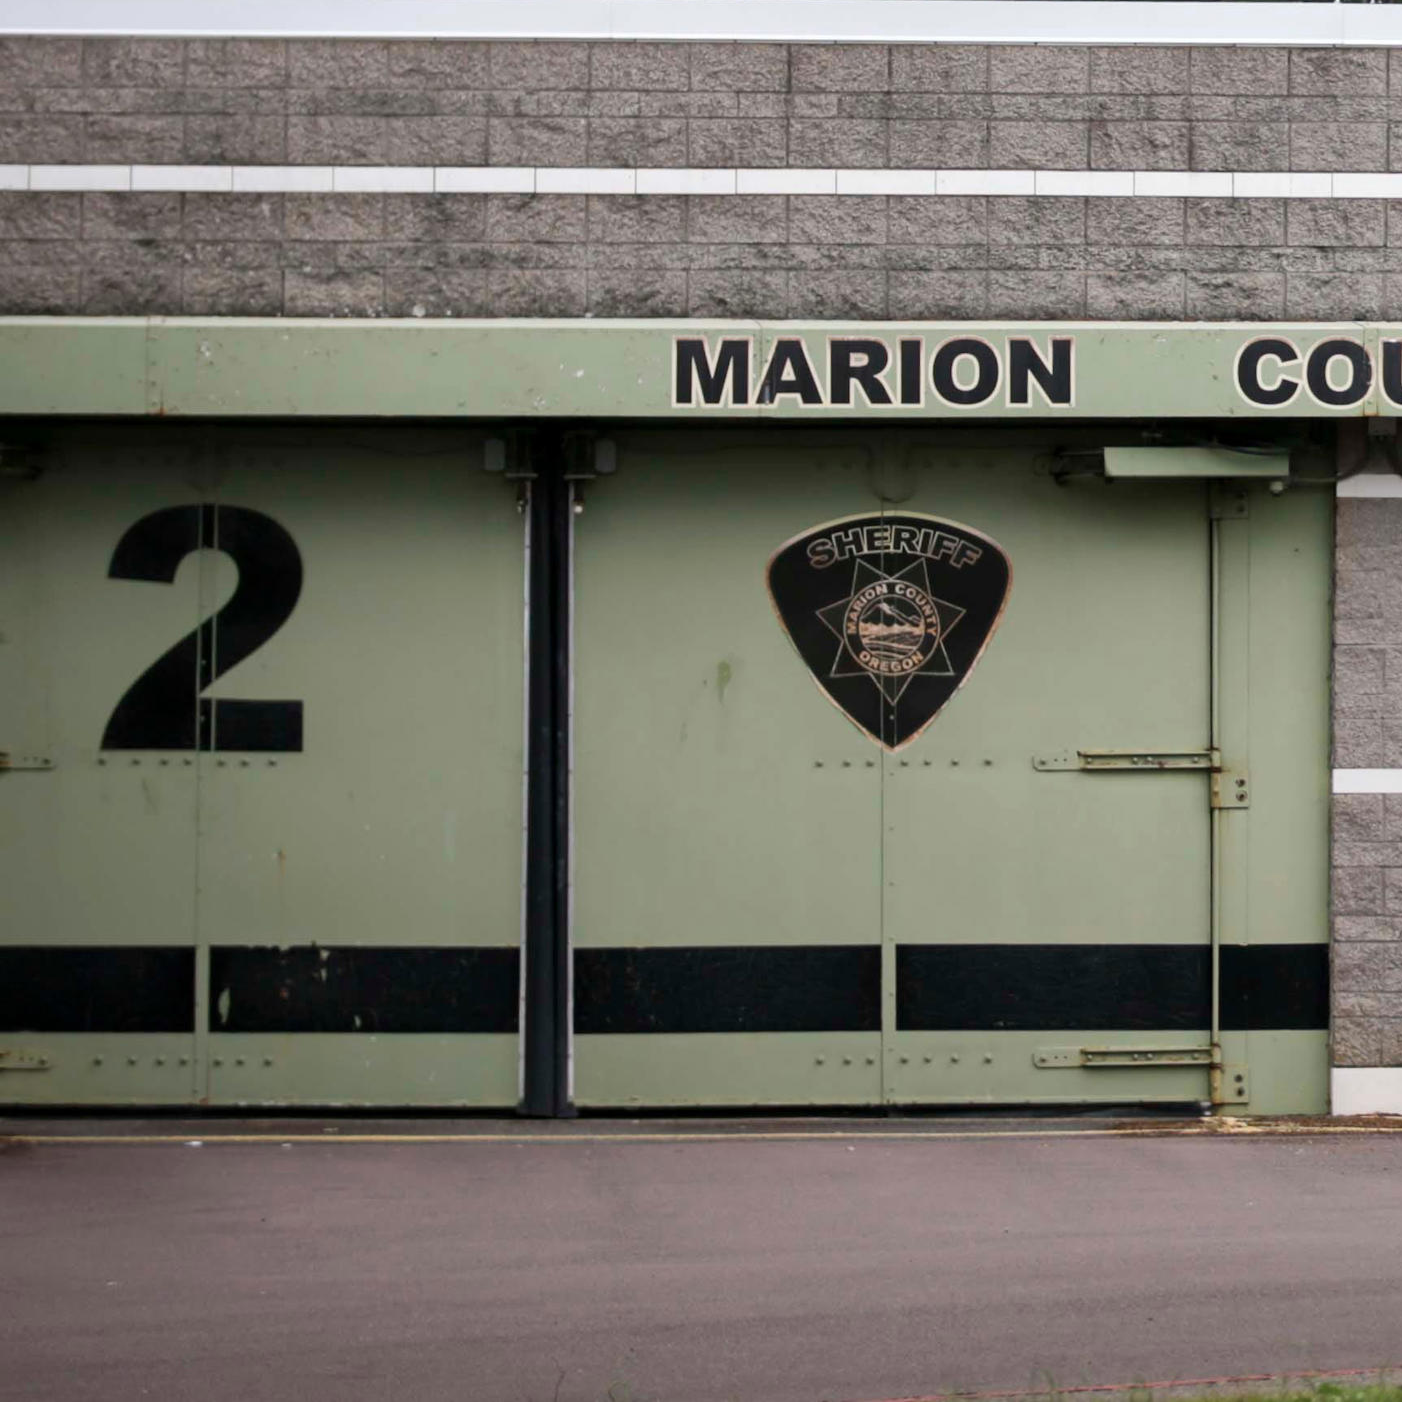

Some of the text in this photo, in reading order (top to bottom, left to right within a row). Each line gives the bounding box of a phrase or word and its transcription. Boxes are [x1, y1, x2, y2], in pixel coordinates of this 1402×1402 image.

[673, 336, 1075, 408] MARION
[807, 525, 983, 569] SHERIFF
[101, 504, 303, 751] 2
[847, 584, 937, 636] MARION COUNTY
[860, 651, 923, 671] OREGON
